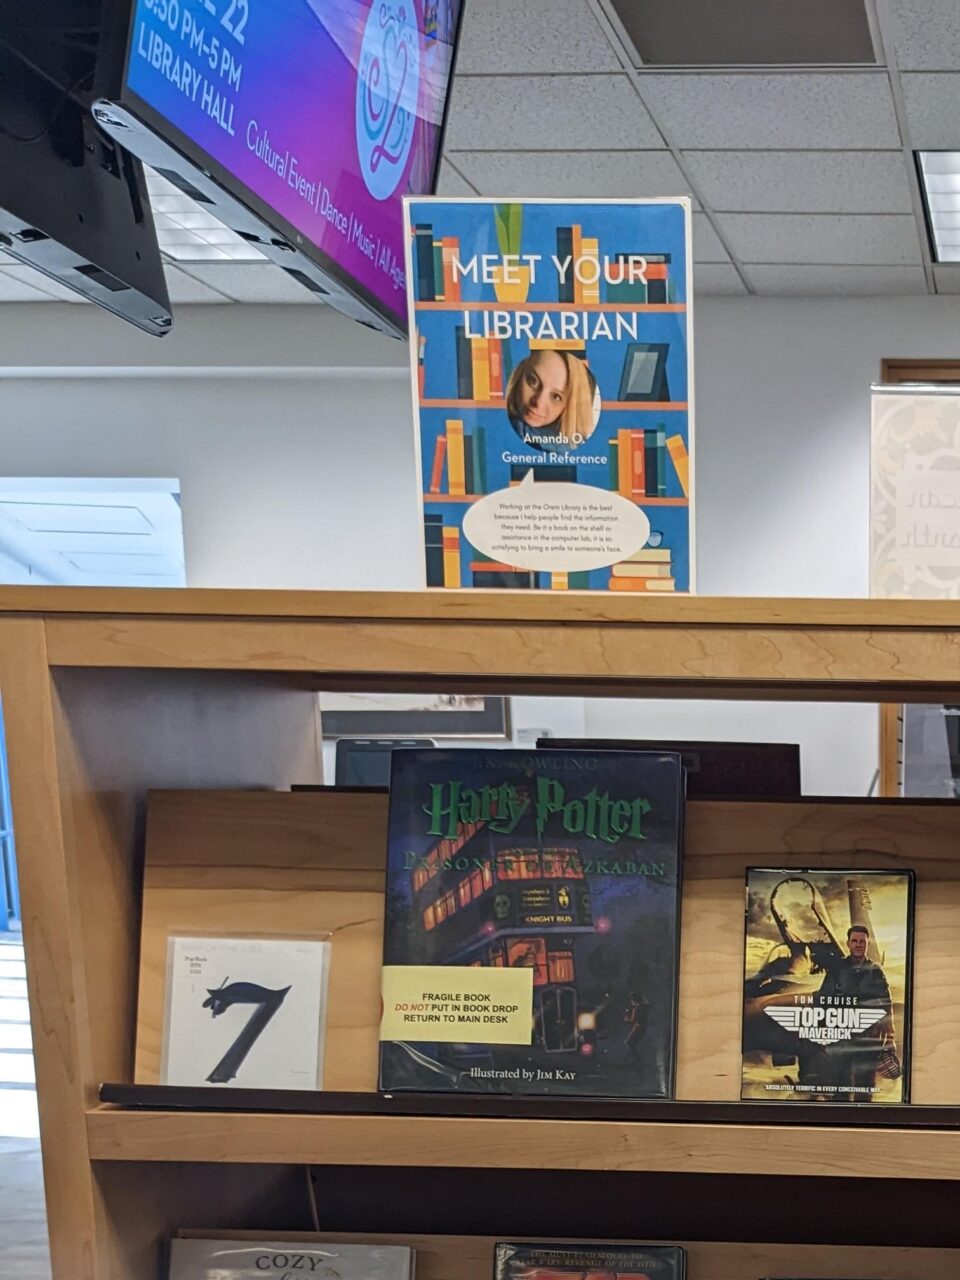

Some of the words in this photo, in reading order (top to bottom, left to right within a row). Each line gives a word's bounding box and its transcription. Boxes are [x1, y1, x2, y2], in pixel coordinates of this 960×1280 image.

[138, 22, 201, 102] LIBRARY
[201, 80, 234, 136] HALL
[247, 120, 288, 179] Cultural
[288, 159, 315, 206] Event
[320, 189, 348, 233] Dance
[353, 219, 375, 259] Music
[452, 255, 541, 284] MEET
[552, 254, 648, 284] YOUR
[465, 312, 638, 341] LIBRARIAN
[524, 433, 567, 444] Amanda
[573, 433, 585, 444] O.
[502, 453, 546, 464] General
[550, 453, 607, 464] Reference
[422, 780, 531, 840] Harry
[536, 777, 651, 844] Potter
[422, 993, 461, 1001] FRAGILE
[464, 994, 490, 1002] BOOK
[794, 996, 813, 1004] TOM
[820, 996, 858, 1005] CRUISE
[395, 1004, 408, 1012] DO
[411, 1004, 429, 1012] NOT
[432, 1004, 448, 1012] PUT
[463, 1005, 489, 1013] BOOK
[492, 1005, 518, 1013] DROP
[404, 1014, 441, 1023] RETURN
[444, 1015, 455, 1023] TO
[458, 1015, 480, 1023] MAIN
[483, 1015, 508, 1024] DESK
[793, 1008, 823, 1027] TOP
[826, 1009, 860, 1028] GUN
[202, 976, 292, 1083] 7
[799, 1027, 852, 1039] MAVERICK
[471, 1067, 519, 1078] Illustrated
[522, 1068, 535, 1081] by
[537, 1069, 553, 1080] JIM
[556, 1069, 576, 1081] KAY
[256, 1254, 323, 1271] COZY
